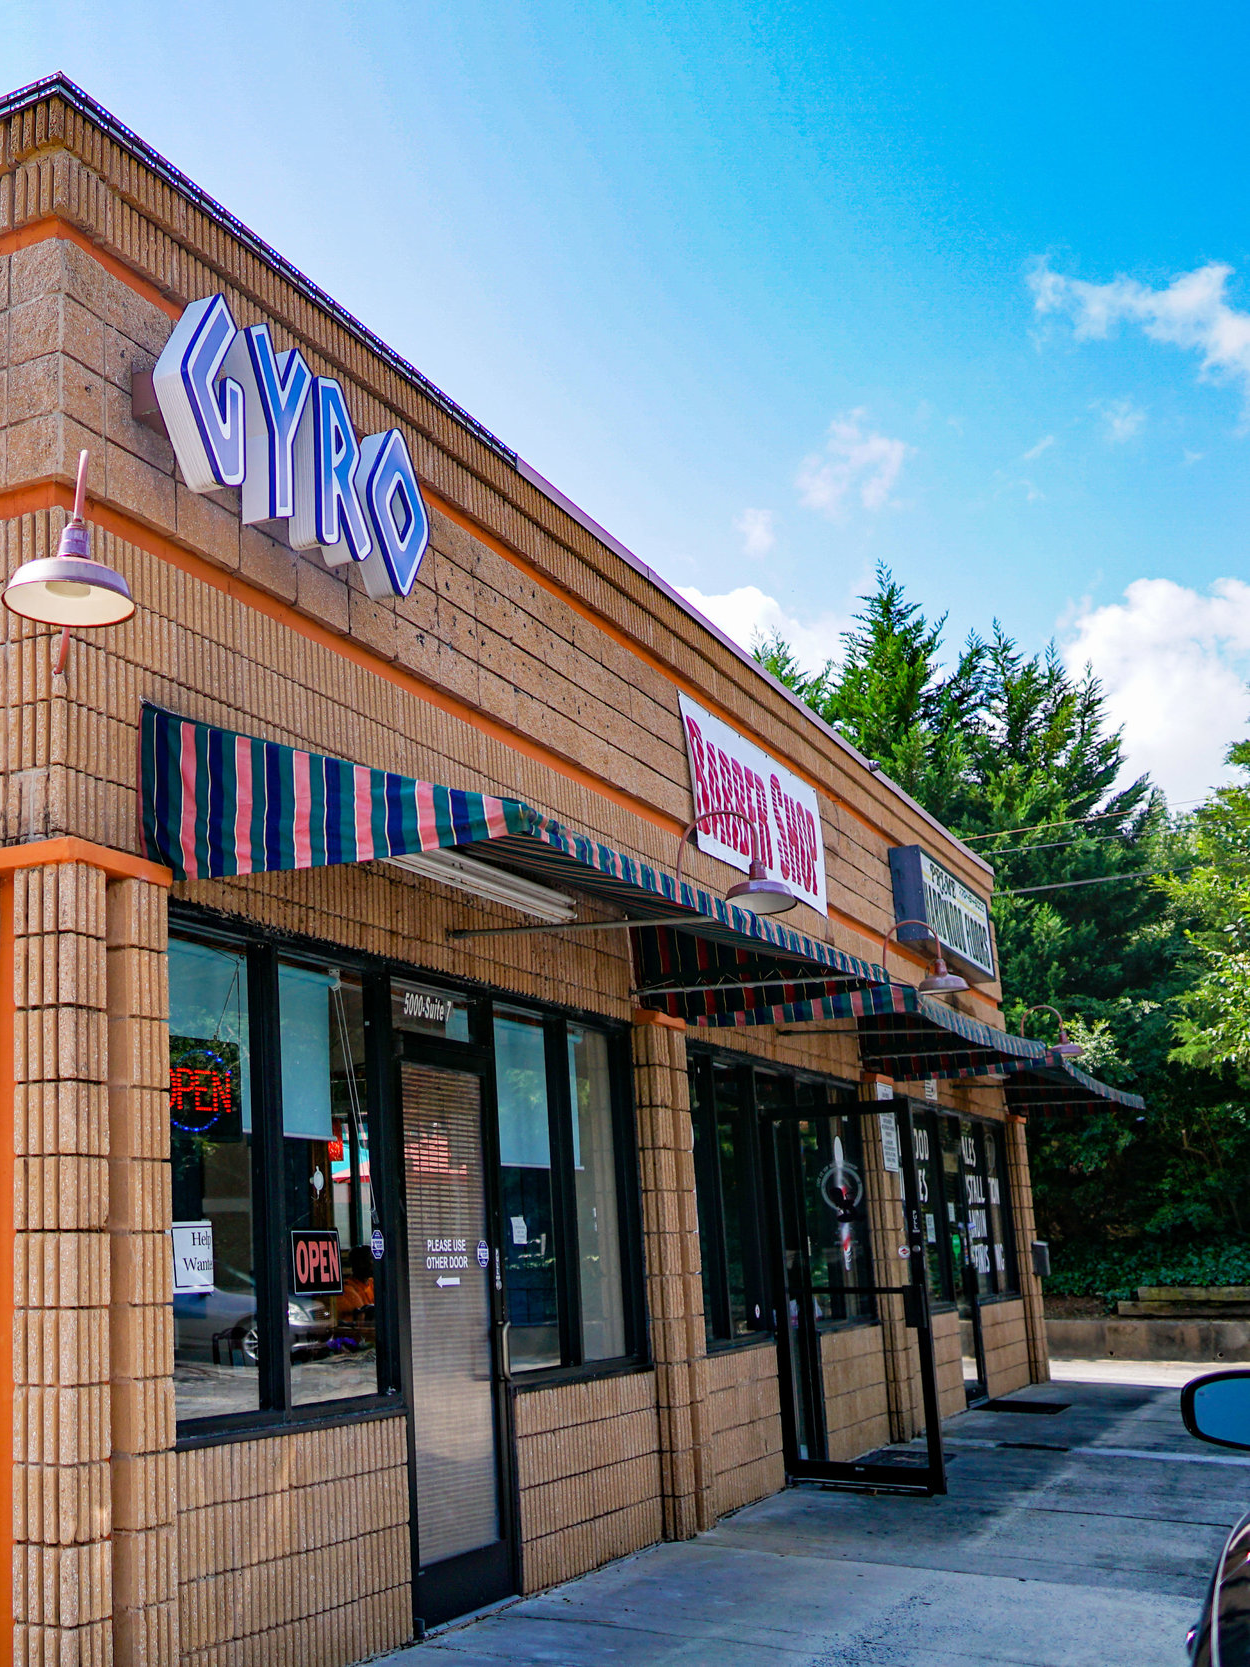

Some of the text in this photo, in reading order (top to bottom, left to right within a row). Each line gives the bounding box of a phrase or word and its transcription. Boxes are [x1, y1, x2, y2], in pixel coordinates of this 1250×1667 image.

[162, 292, 430, 600] GYRO
[686, 715, 817, 896] BARBER SHOP
[404, 992, 452, 1022] 5000-Suite 7
[191, 1231, 211, 1249] Help
[427, 1239, 467, 1252] PLEASE USE
[296, 1240, 340, 1284] OPEN
[426, 1256, 469, 1269] OTHER DOOR
